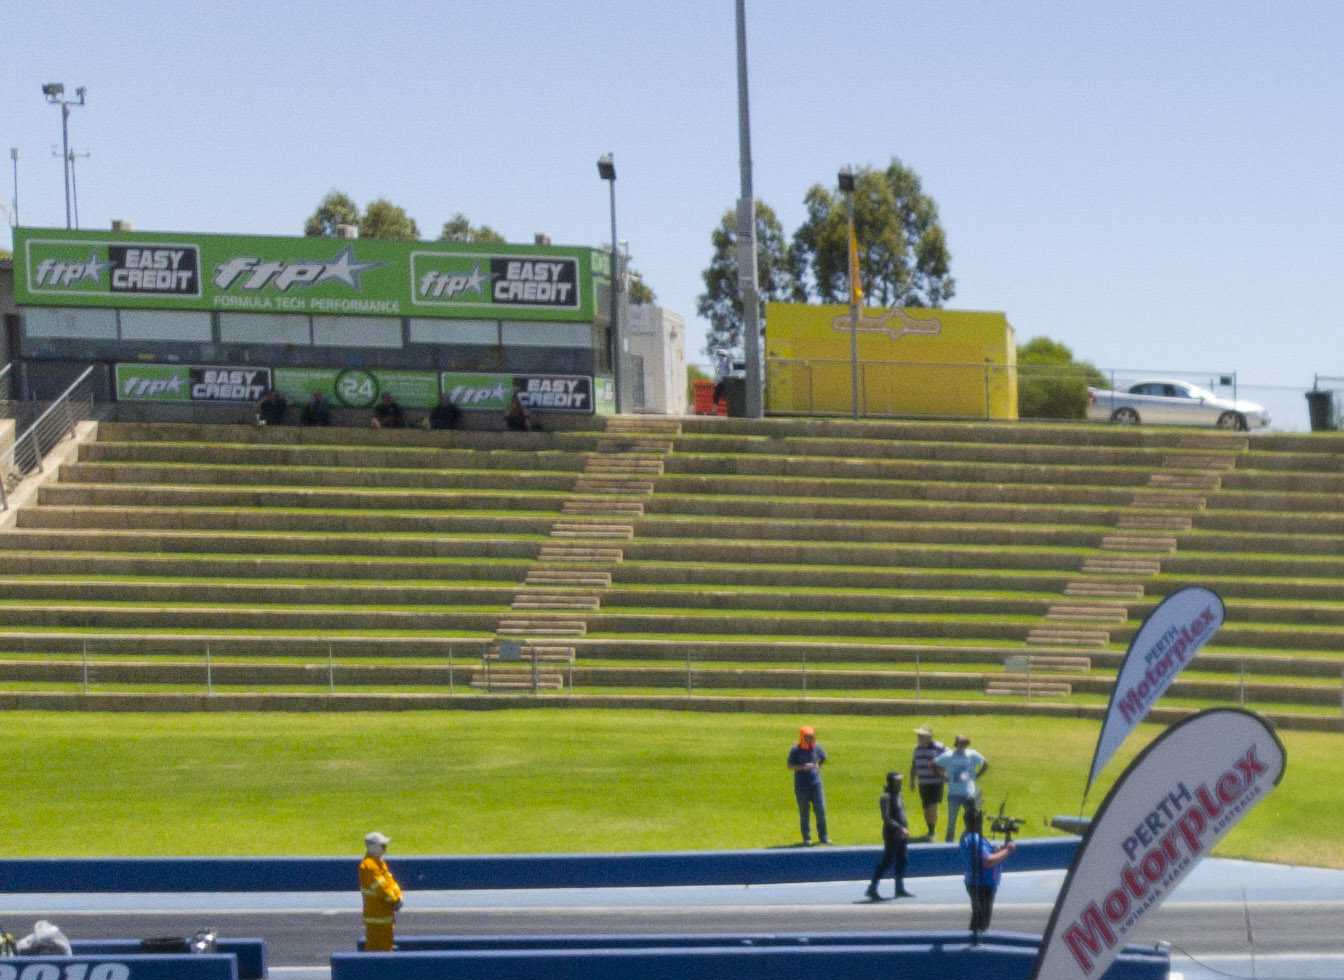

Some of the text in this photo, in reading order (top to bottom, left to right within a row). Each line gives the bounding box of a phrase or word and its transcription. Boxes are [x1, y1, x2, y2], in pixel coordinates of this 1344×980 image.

[125, 249, 184, 270] EASY
[112, 269, 192, 290] CREDIT
[213, 257, 326, 292] ftp
[506, 261, 563, 282] EASY
[494, 280, 572, 302] CREDIT
[214, 296, 400, 313] FORMULA TECH PERFORMANCE
[204, 371, 256, 385] EASY
[527, 378, 578, 393] EASY
[192, 384, 264, 399] CREDIT
[1144, 623, 1178, 664] PERTH
[1117, 605, 1215, 724] Motorplex
[1122, 781, 1192, 861] PERTH
[1062, 743, 1269, 976] Motorplex
